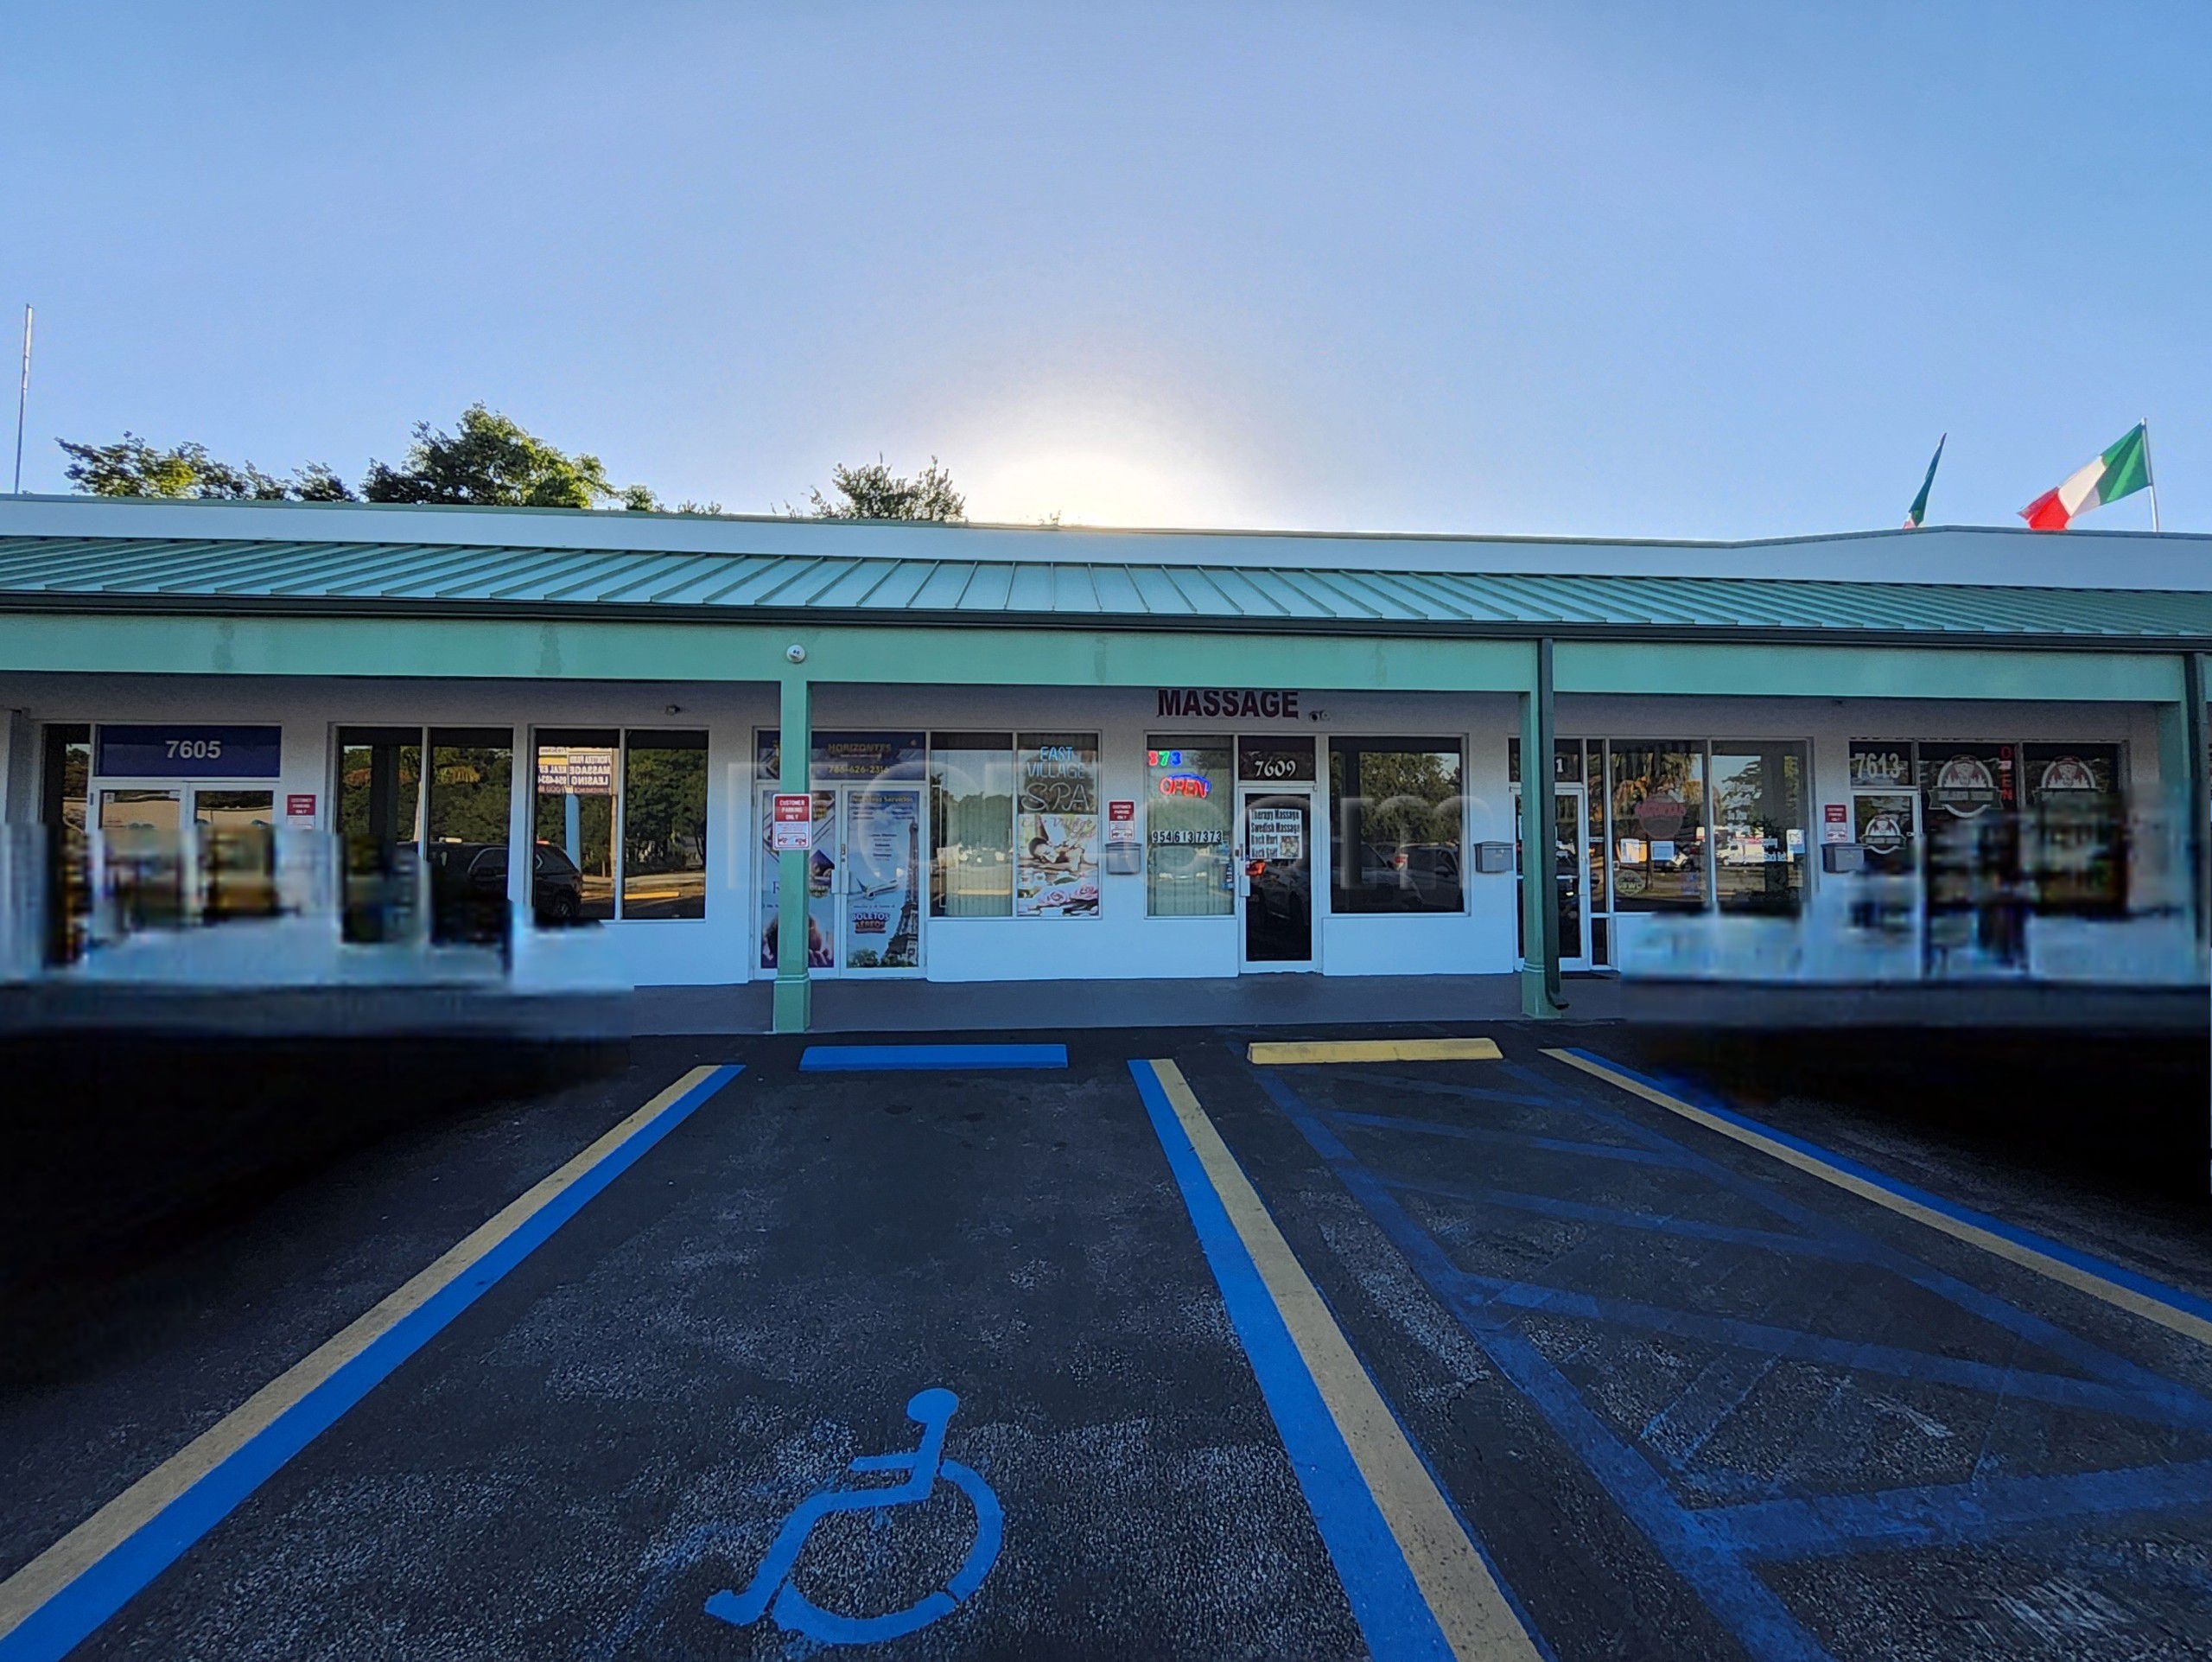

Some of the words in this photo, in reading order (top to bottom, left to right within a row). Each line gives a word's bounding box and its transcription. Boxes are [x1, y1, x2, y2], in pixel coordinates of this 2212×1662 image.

[1157, 690, 1299, 719] MASSAGE
[165, 741, 222, 759] 7605
[1039, 746, 1073, 761] EAST
[1027, 761, 1086, 778] VILLAGE
[1254, 760, 1296, 777] 7609
[1854, 753, 1901, 779] 7613
[1021, 782, 1090, 811] SPA
[1160, 777, 1208, 799] OPEN
